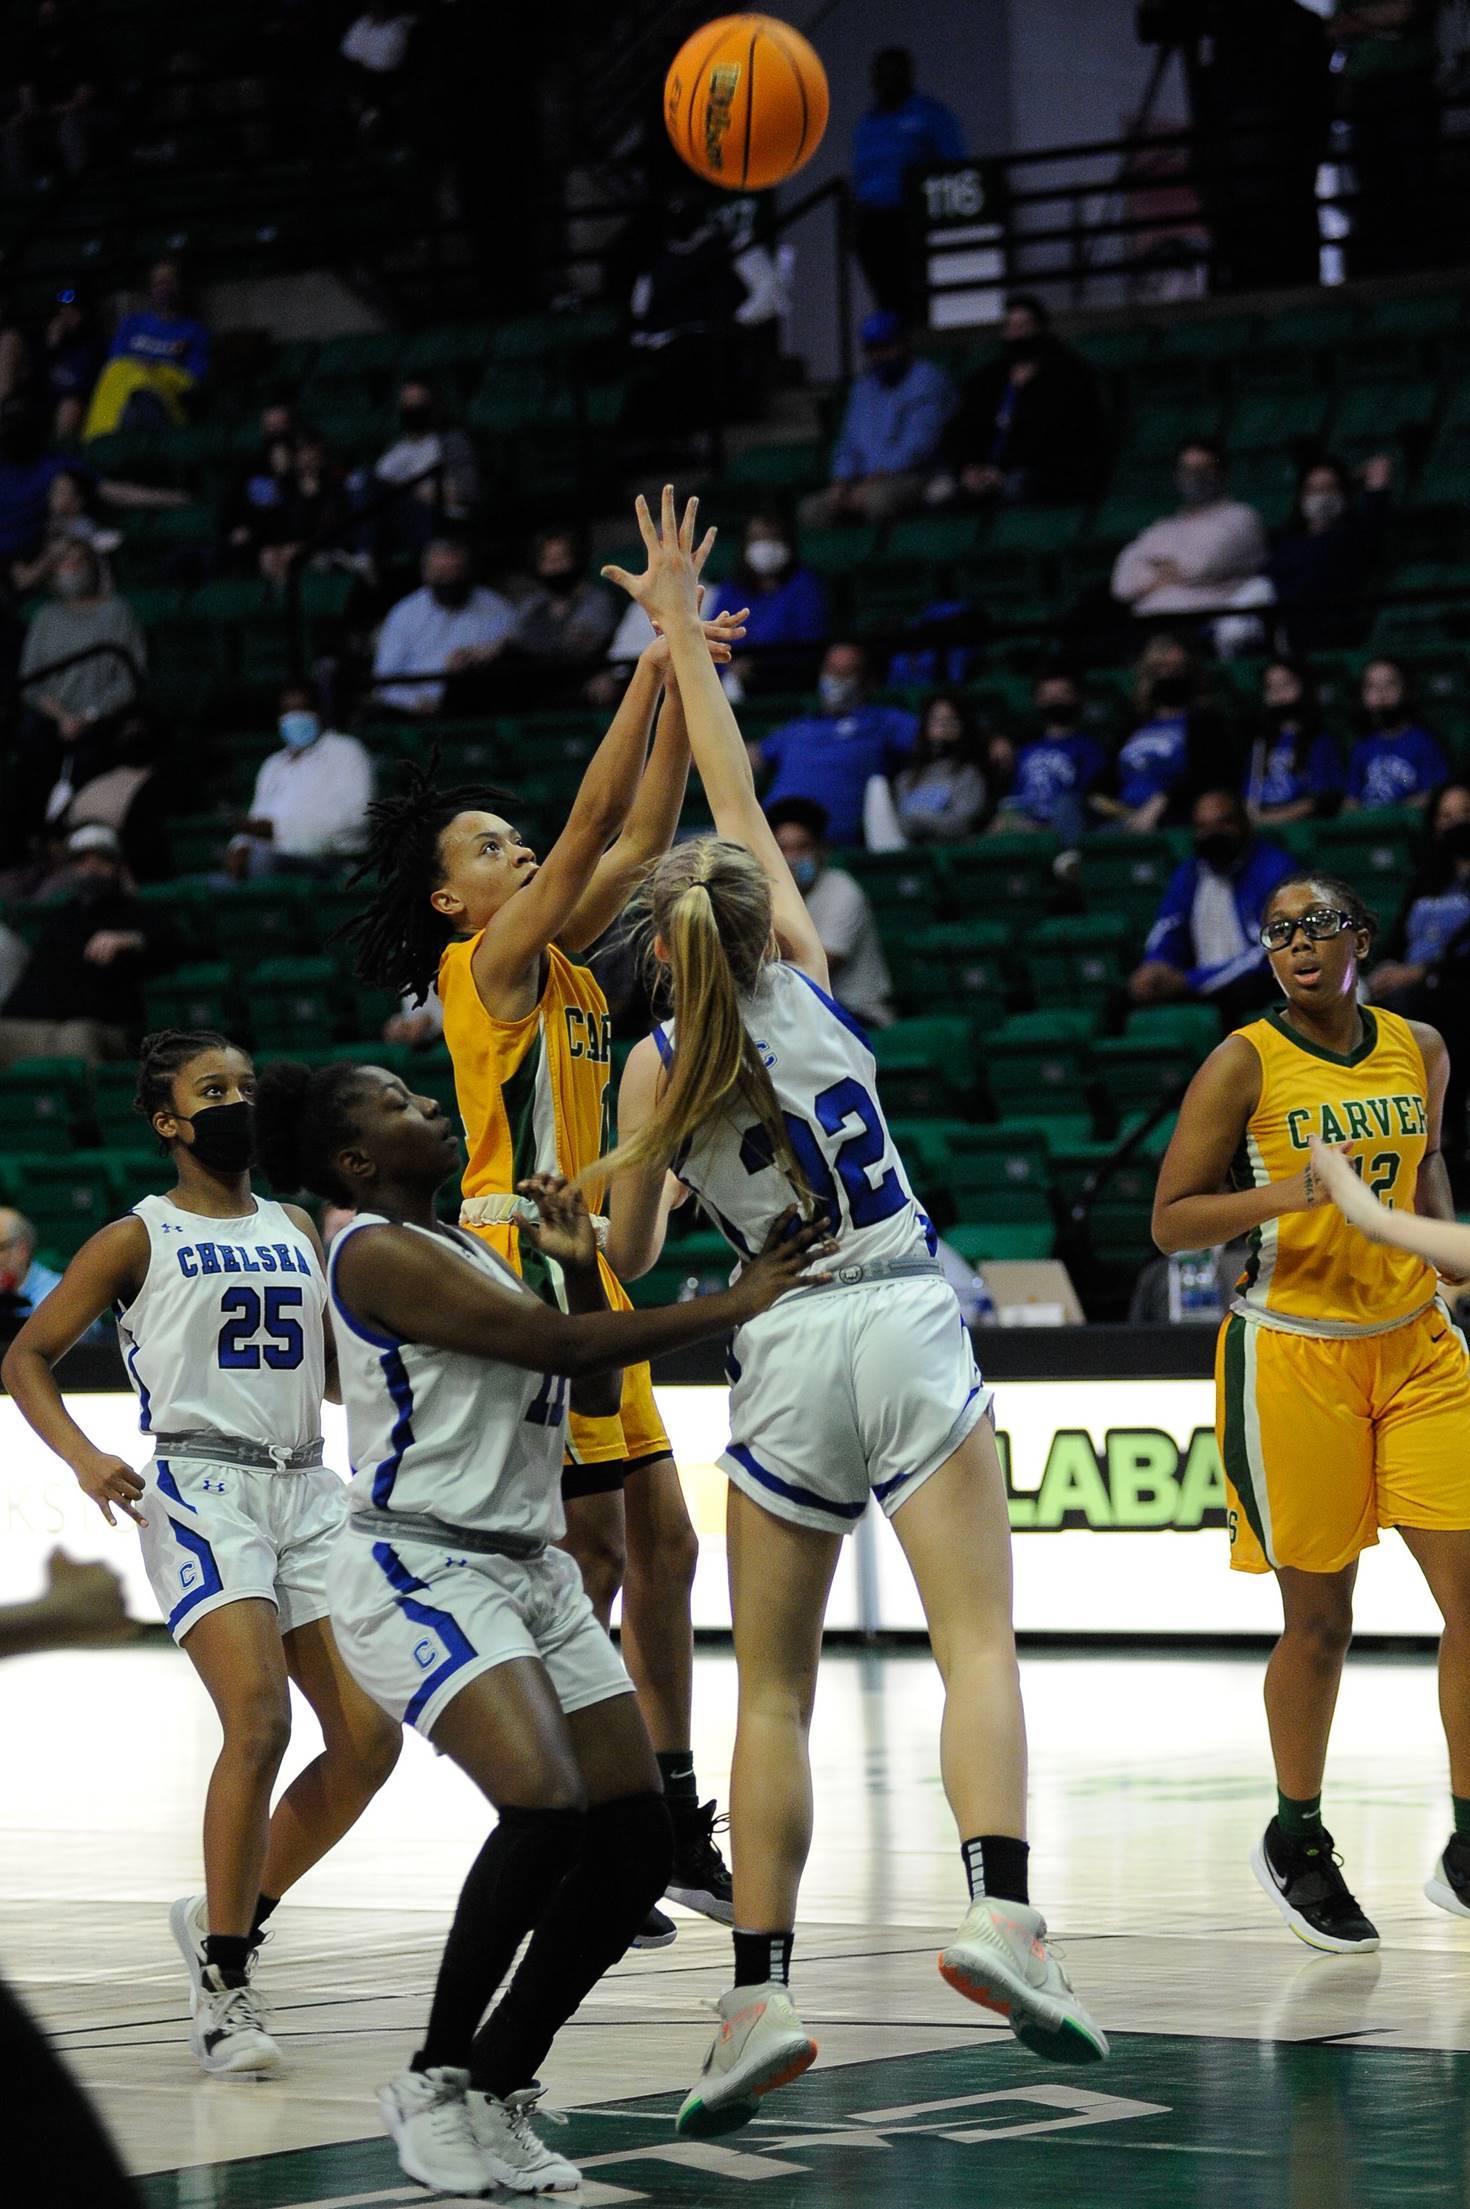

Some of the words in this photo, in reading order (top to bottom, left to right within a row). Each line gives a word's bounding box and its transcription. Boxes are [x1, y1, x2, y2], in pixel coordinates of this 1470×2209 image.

[177, 1242, 311, 1278] CHELSEA
[218, 1286, 304, 1370] 25
[178, 1561, 197, 1590] C
[412, 1637, 438, 1673] C
